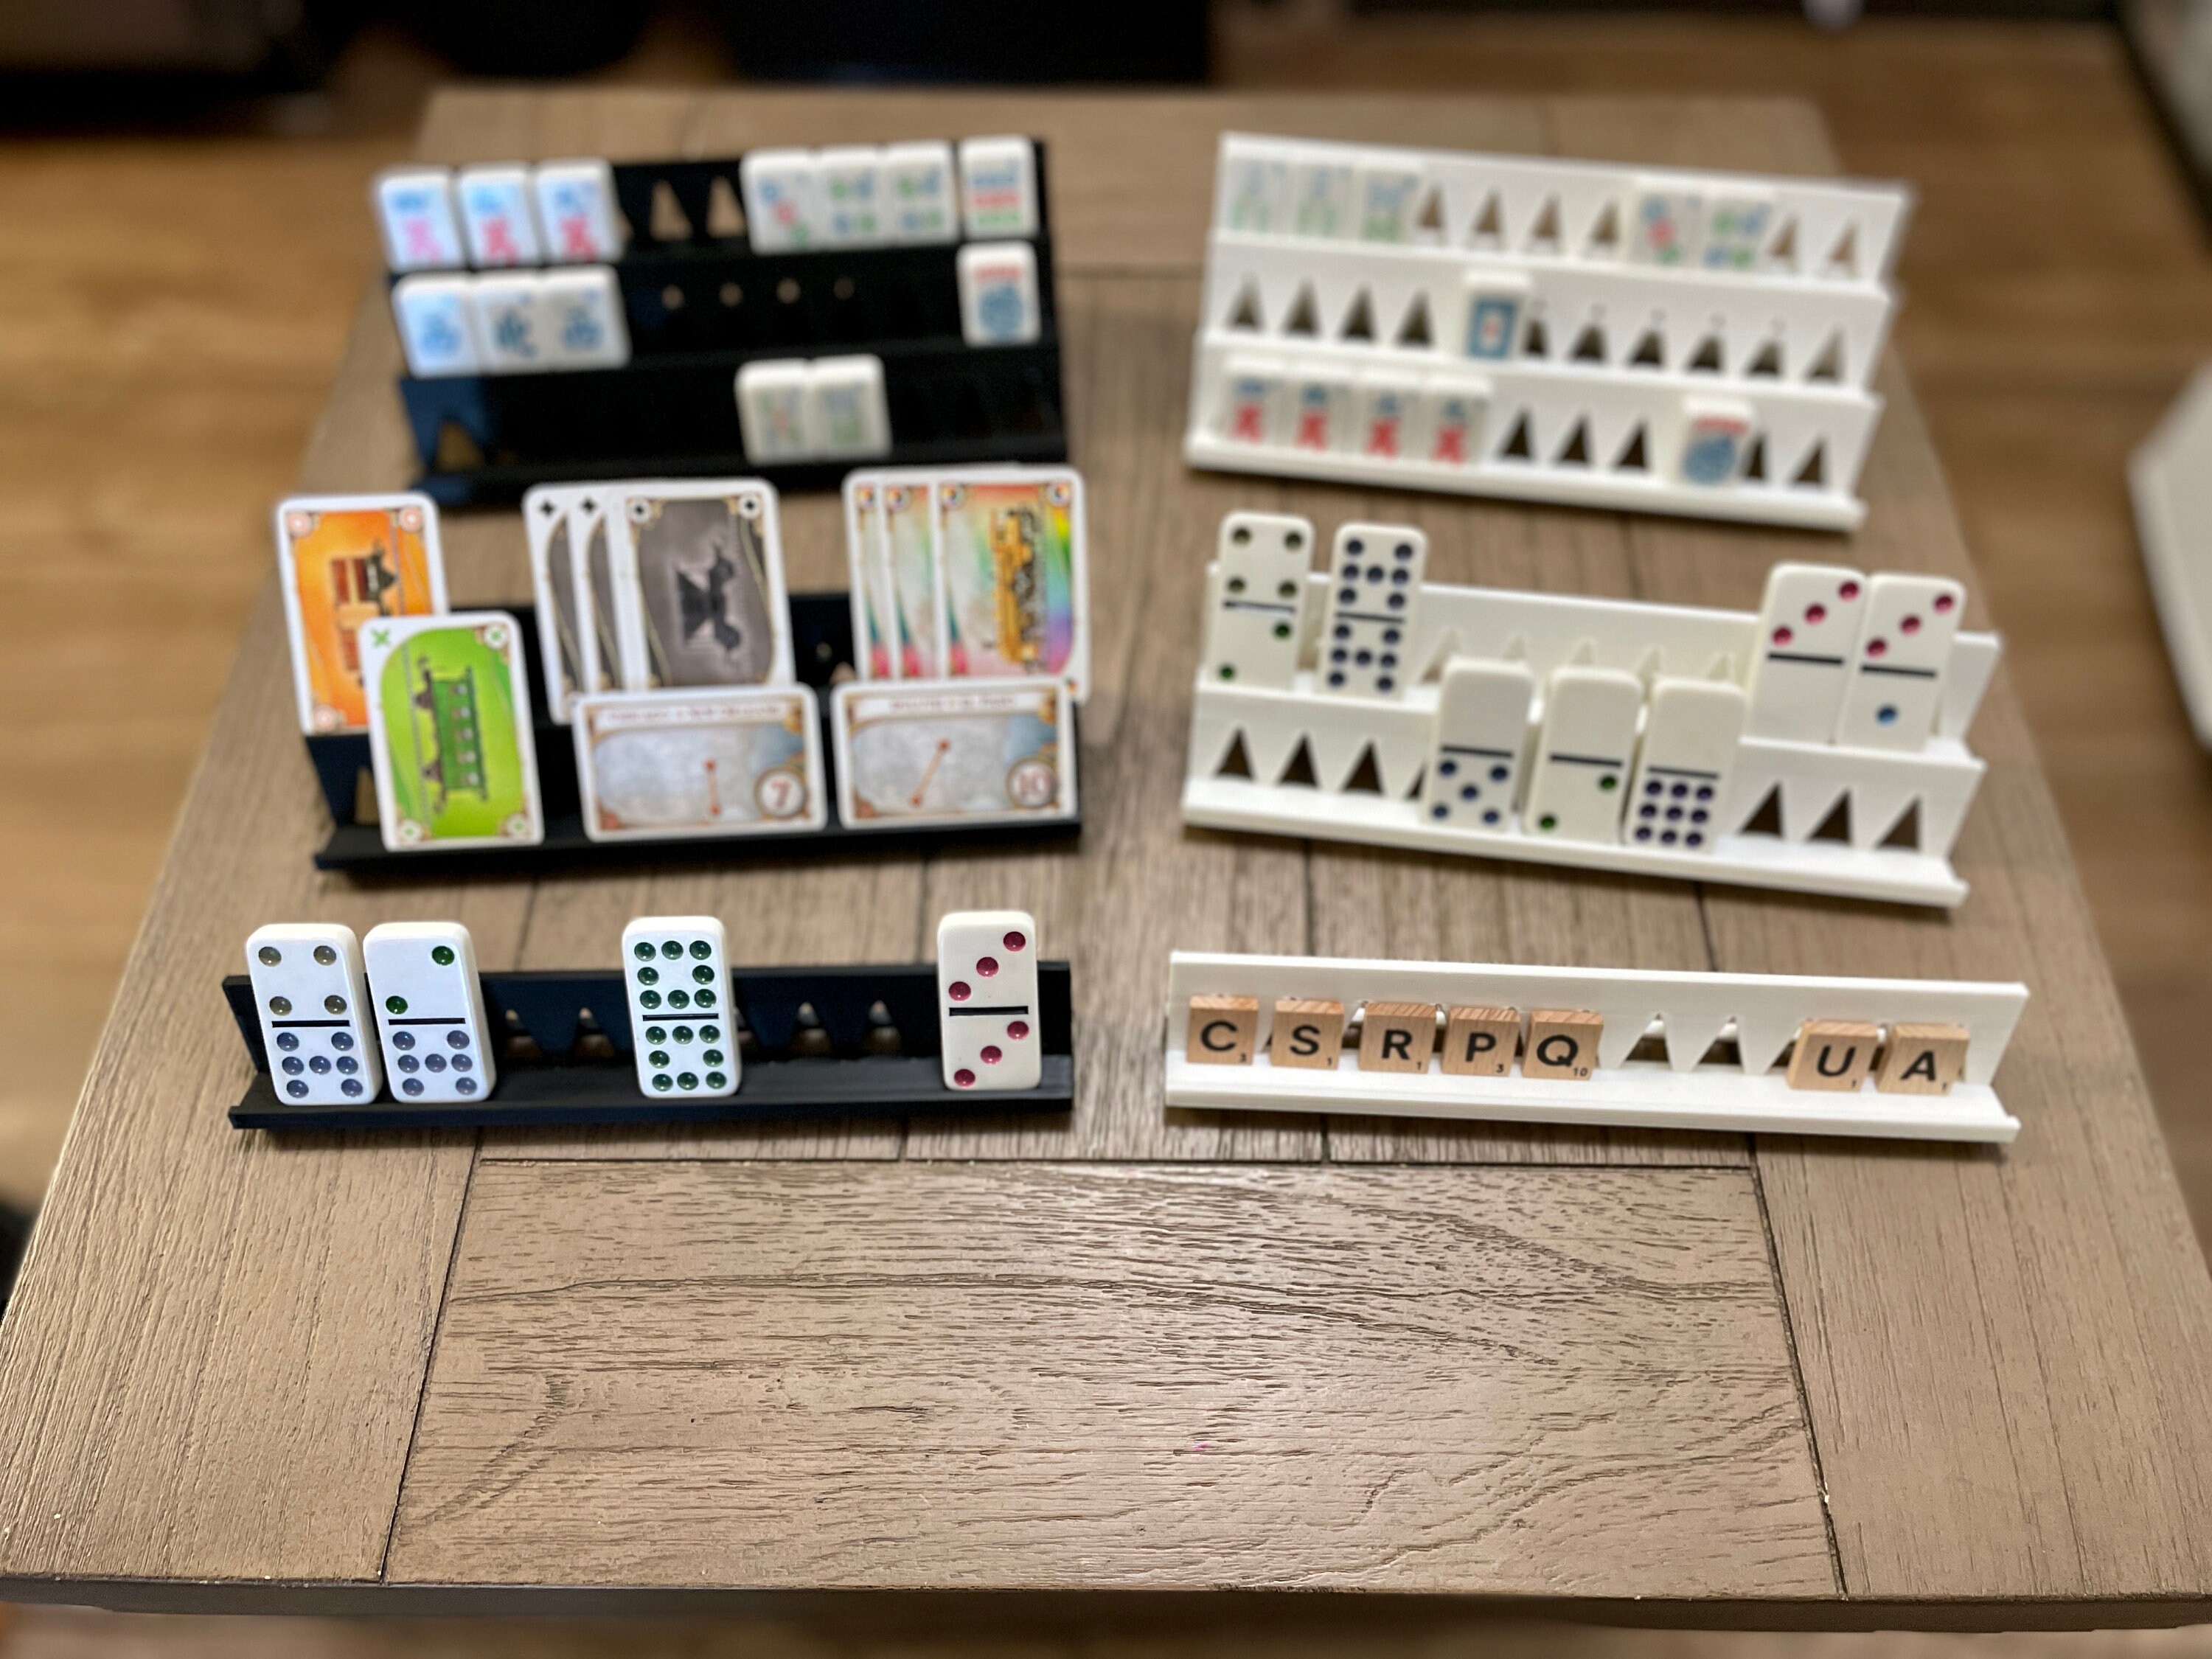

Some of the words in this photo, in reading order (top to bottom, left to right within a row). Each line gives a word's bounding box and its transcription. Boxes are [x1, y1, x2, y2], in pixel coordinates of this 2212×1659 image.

[770, 780, 791, 809] 7
[1200, 1019, 1238, 1052] C
[1290, 1024, 1321, 1056] S
[1381, 1029, 1413, 1060] R
[1465, 1032, 1496, 1062] P
[1536, 1034, 1579, 1067] Q
[1816, 1044, 1857, 1077] U
[1899, 1050, 1936, 1082] A
[1326, 1057, 1332, 1066] 1
[1416, 1061, 1422, 1071] 1
[1495, 1064, 1504, 1074] 3
[1573, 1067, 1588, 1077] 10
